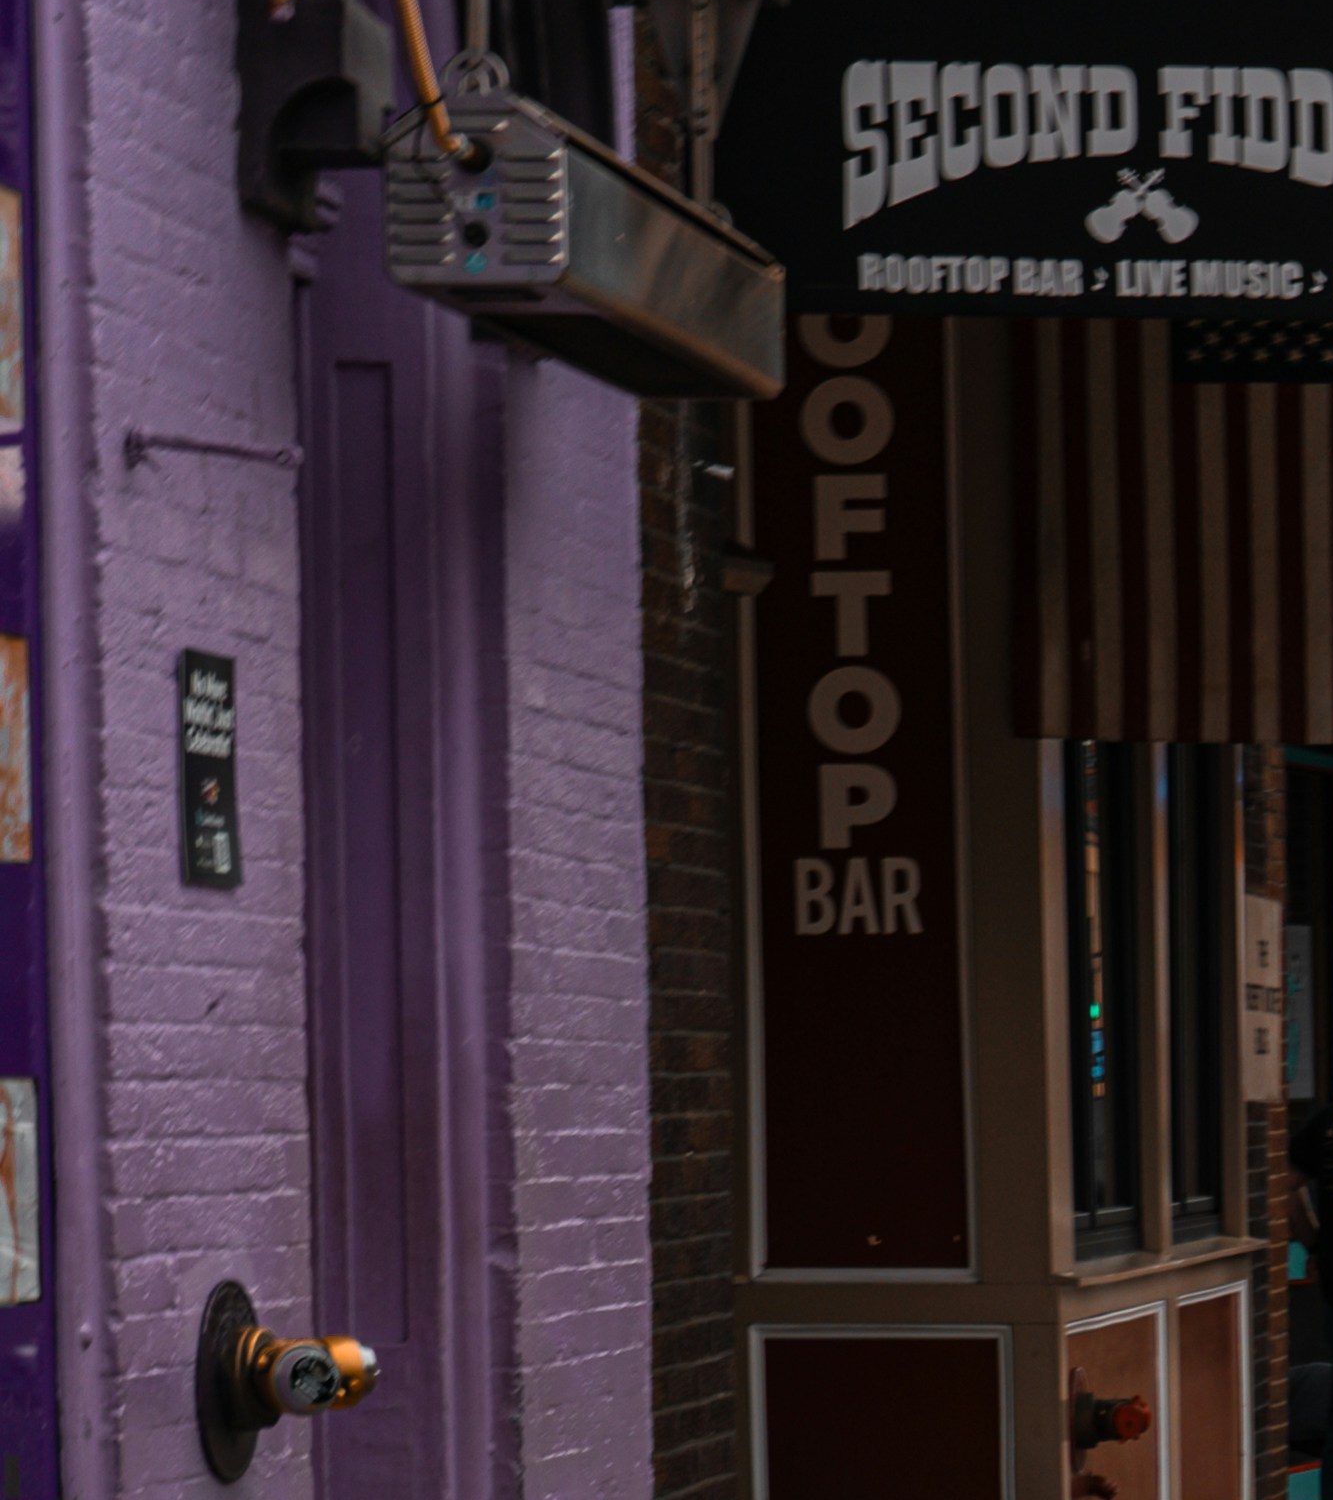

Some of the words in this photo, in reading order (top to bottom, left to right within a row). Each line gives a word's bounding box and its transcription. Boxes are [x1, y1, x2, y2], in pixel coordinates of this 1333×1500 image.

[842, 59, 1138, 231] SECOND
[858, 252, 1009, 293] ROOFTOP
[1012, 258, 1084, 297] BAR
[1115, 259, 1187, 298] LIVE
[1190, 260, 1303, 299] MUSIC
[793, 856, 923, 938] BAR
